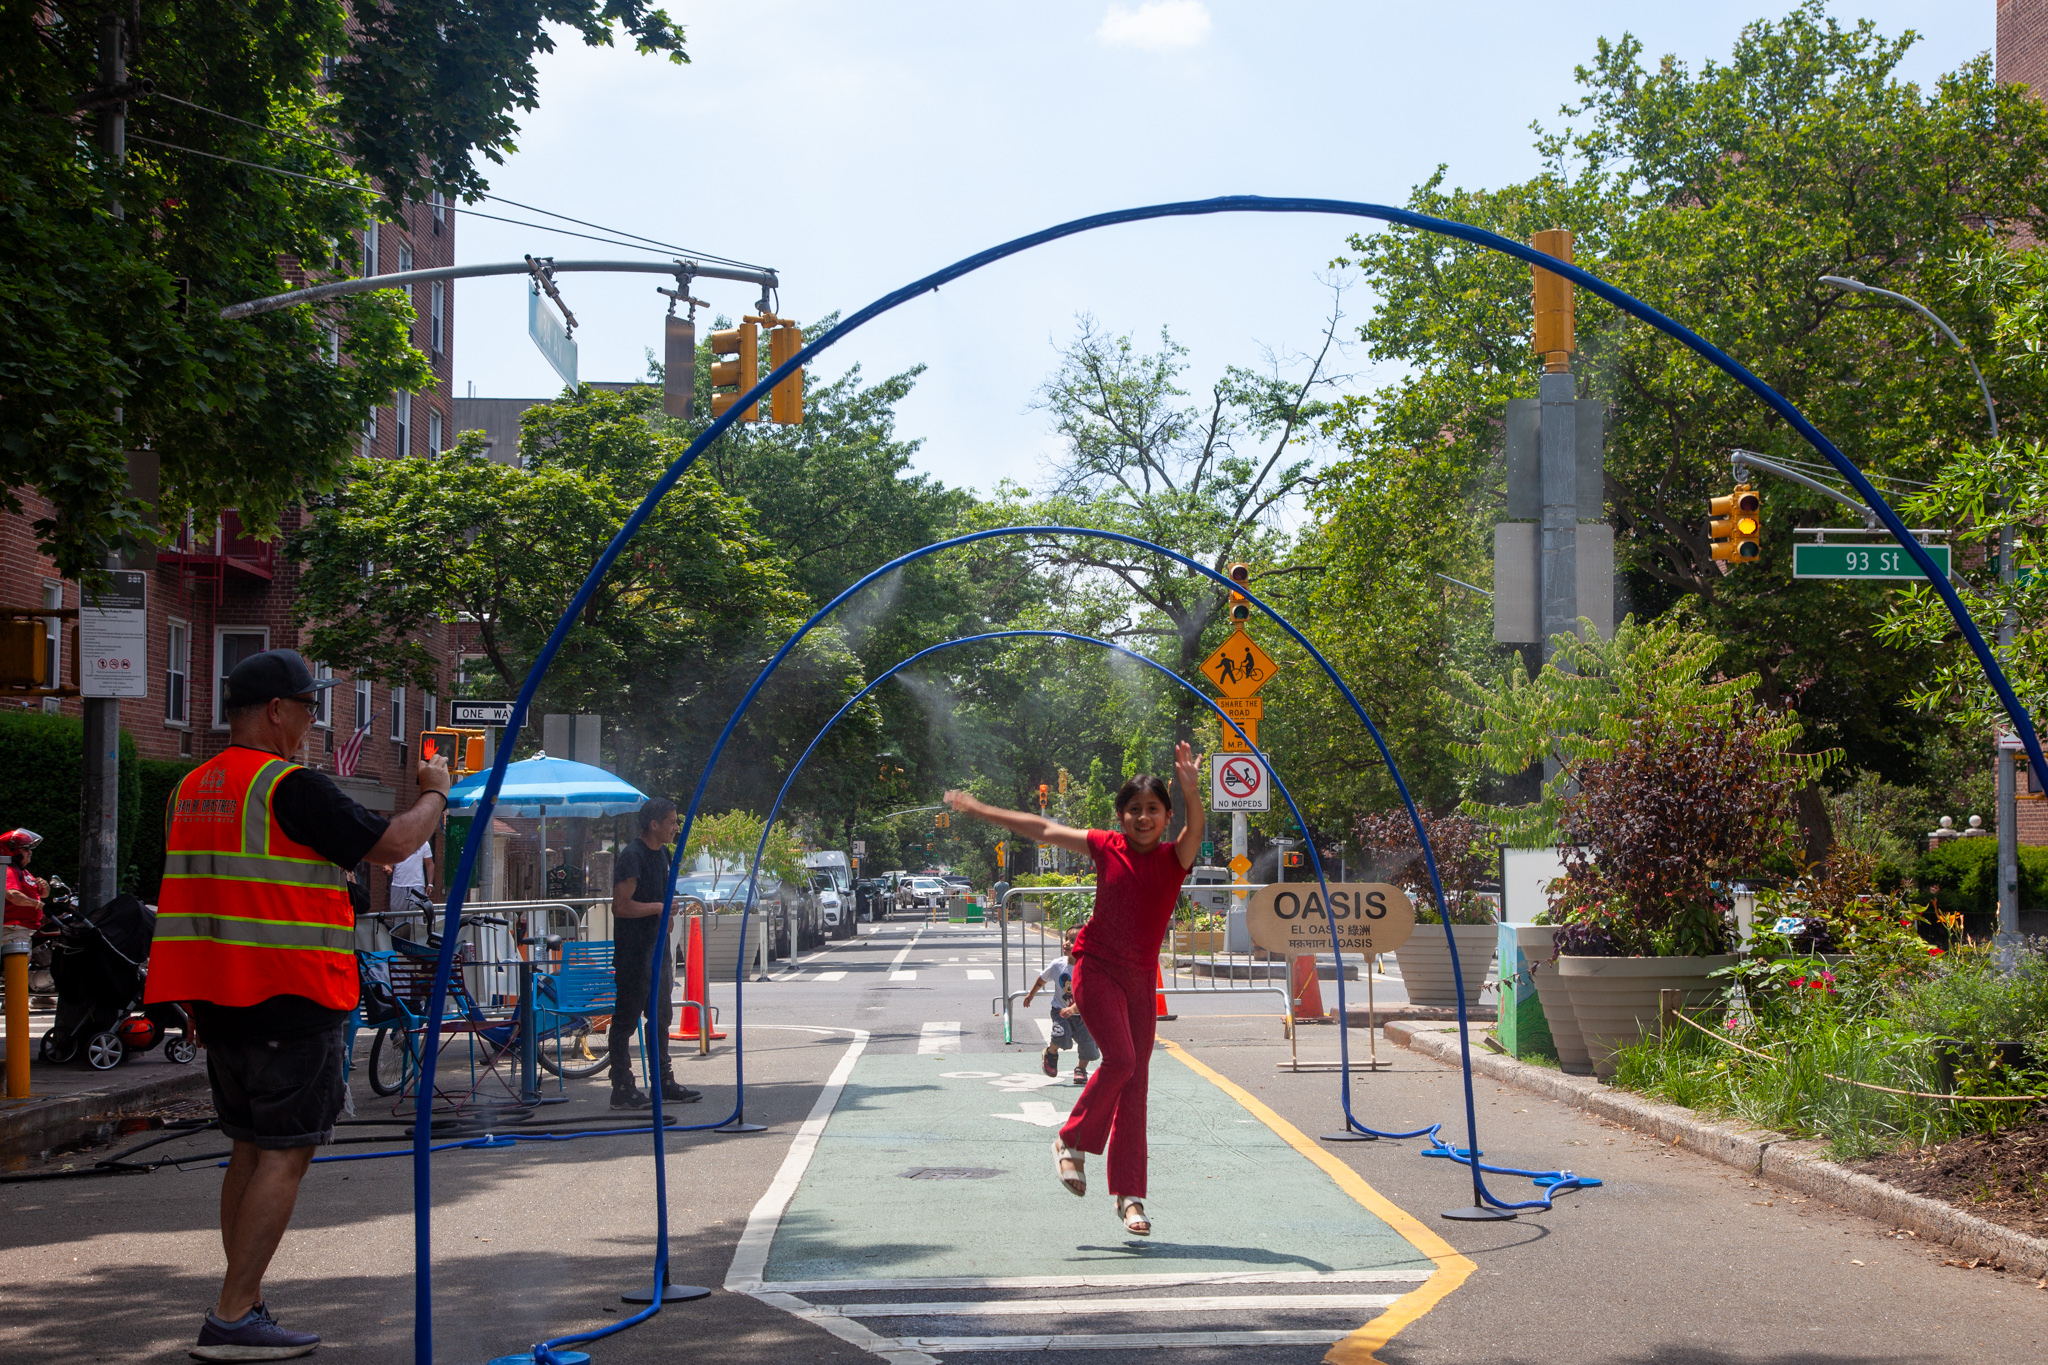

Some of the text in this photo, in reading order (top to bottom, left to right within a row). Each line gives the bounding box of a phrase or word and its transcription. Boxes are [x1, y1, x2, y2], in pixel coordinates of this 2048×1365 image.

[543, 314, 563, 363] 34 AV
[1846, 552, 1900, 571] 93 St
[462, 709, 484, 719] ONE
[1234, 722, 1246, 738] 5
[1041, 858, 1050, 866] 10
[1274, 891, 1387, 920] OASIS
[1291, 925, 1344, 934] EL OASS
